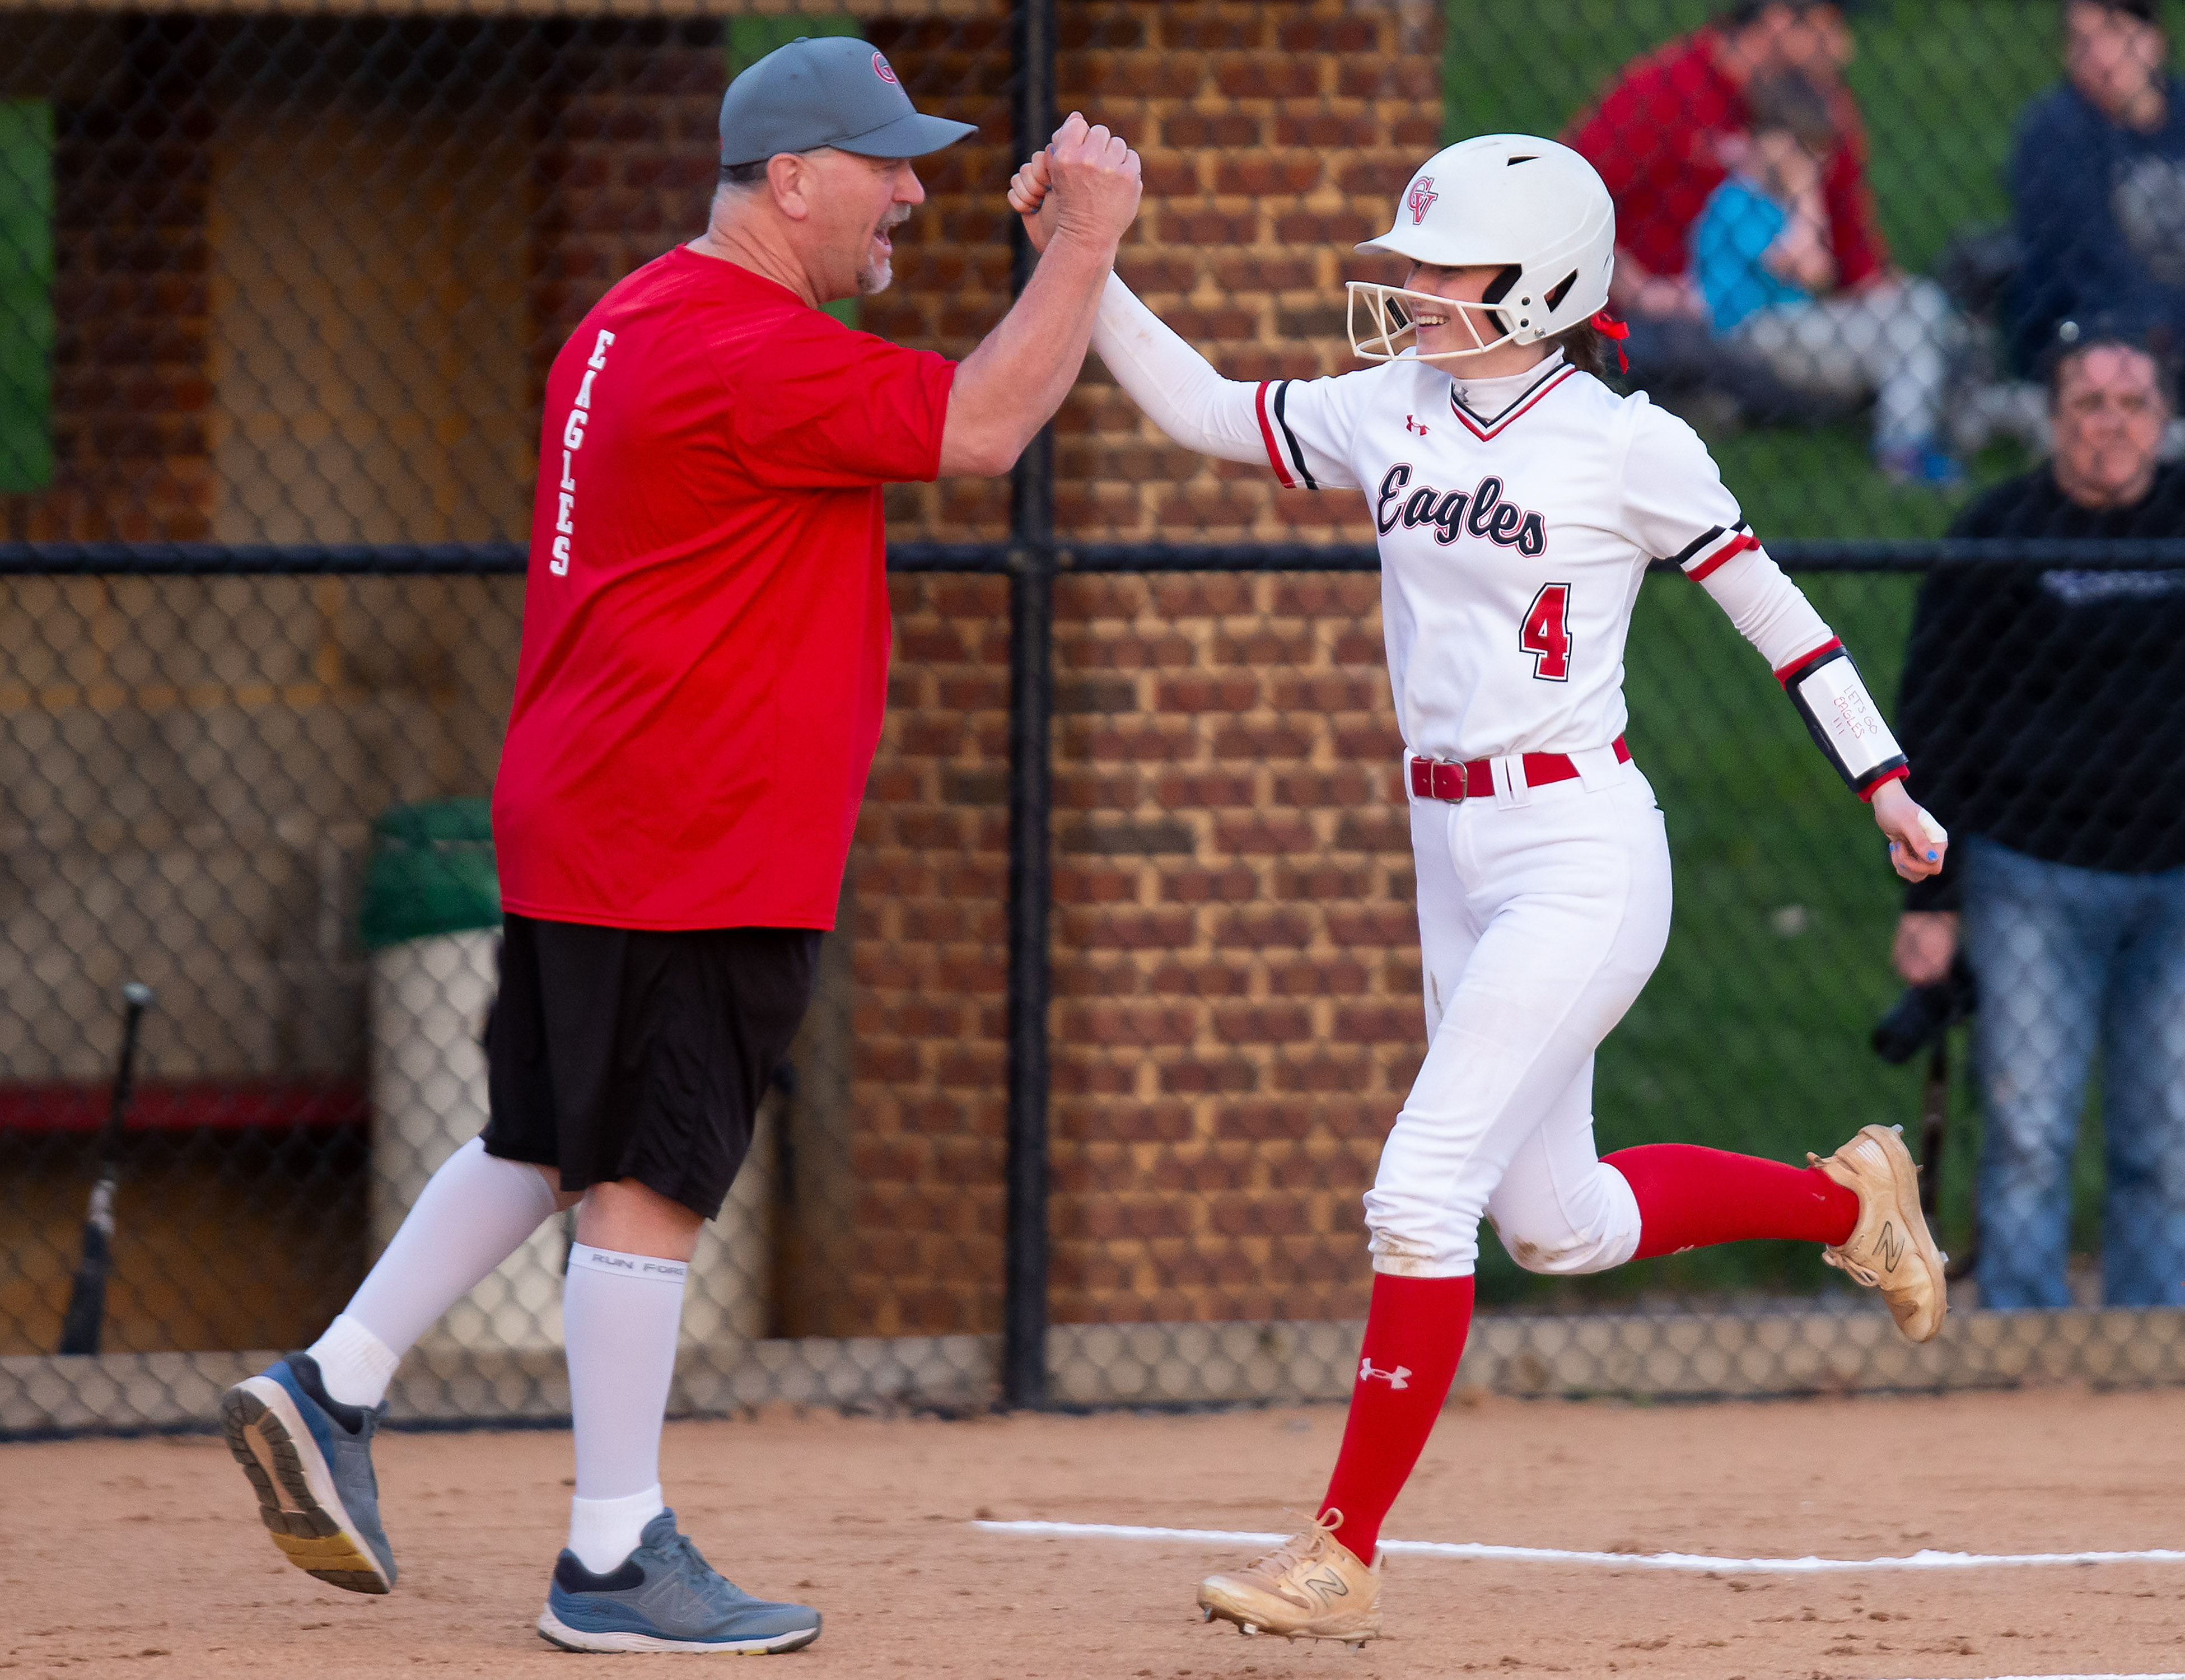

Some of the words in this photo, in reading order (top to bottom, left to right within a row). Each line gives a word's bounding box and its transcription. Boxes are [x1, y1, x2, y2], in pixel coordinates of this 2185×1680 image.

[549, 329, 615, 577] EAGLES
[1377, 463, 1547, 558] Eagles
[1519, 582, 1572, 682] 4
[1834, 696, 1865, 739] EAGLES
[1864, 716, 1877, 734] GO
[592, 1254, 633, 1270] RUN
